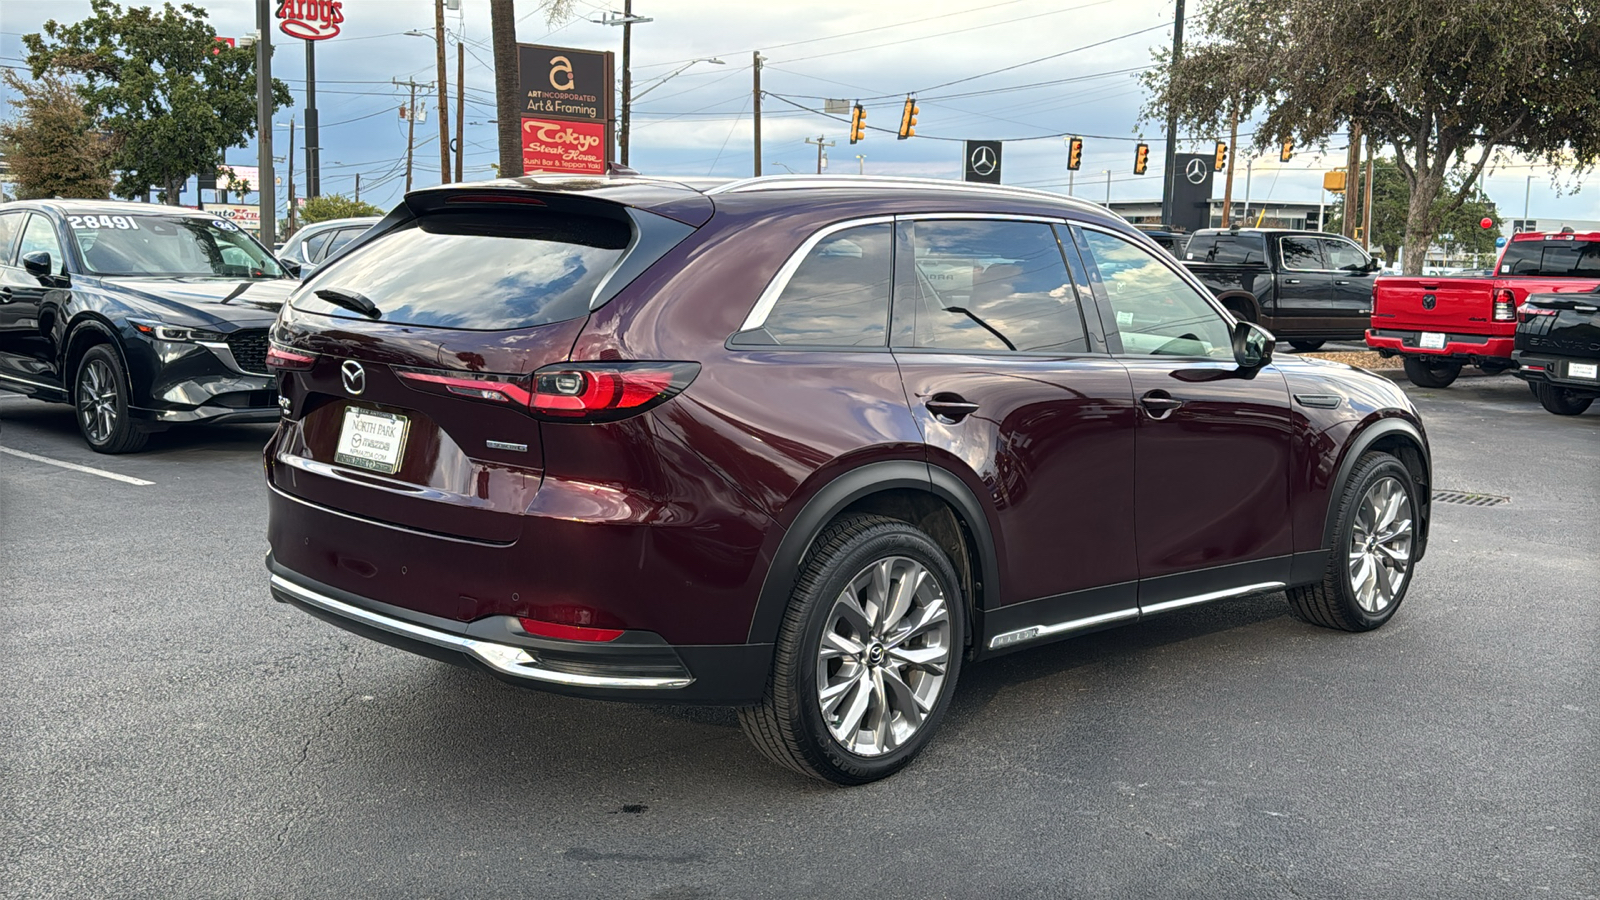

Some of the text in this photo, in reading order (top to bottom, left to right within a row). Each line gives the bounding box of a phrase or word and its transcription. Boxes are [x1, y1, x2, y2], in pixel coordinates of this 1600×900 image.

[278, 0, 344, 29] Arbys
[527, 99, 597, 118] Art & Framing
[523, 120, 600, 152] Tokyo
[523, 142, 602, 162] Steak House
[523, 157, 541, 165] Sushi
[562, 160, 587, 169] Teppan
[67, 215, 139, 230] 28491
[352, 419, 396, 438] NORTH PARK
[362, 437, 391, 451] mazda
